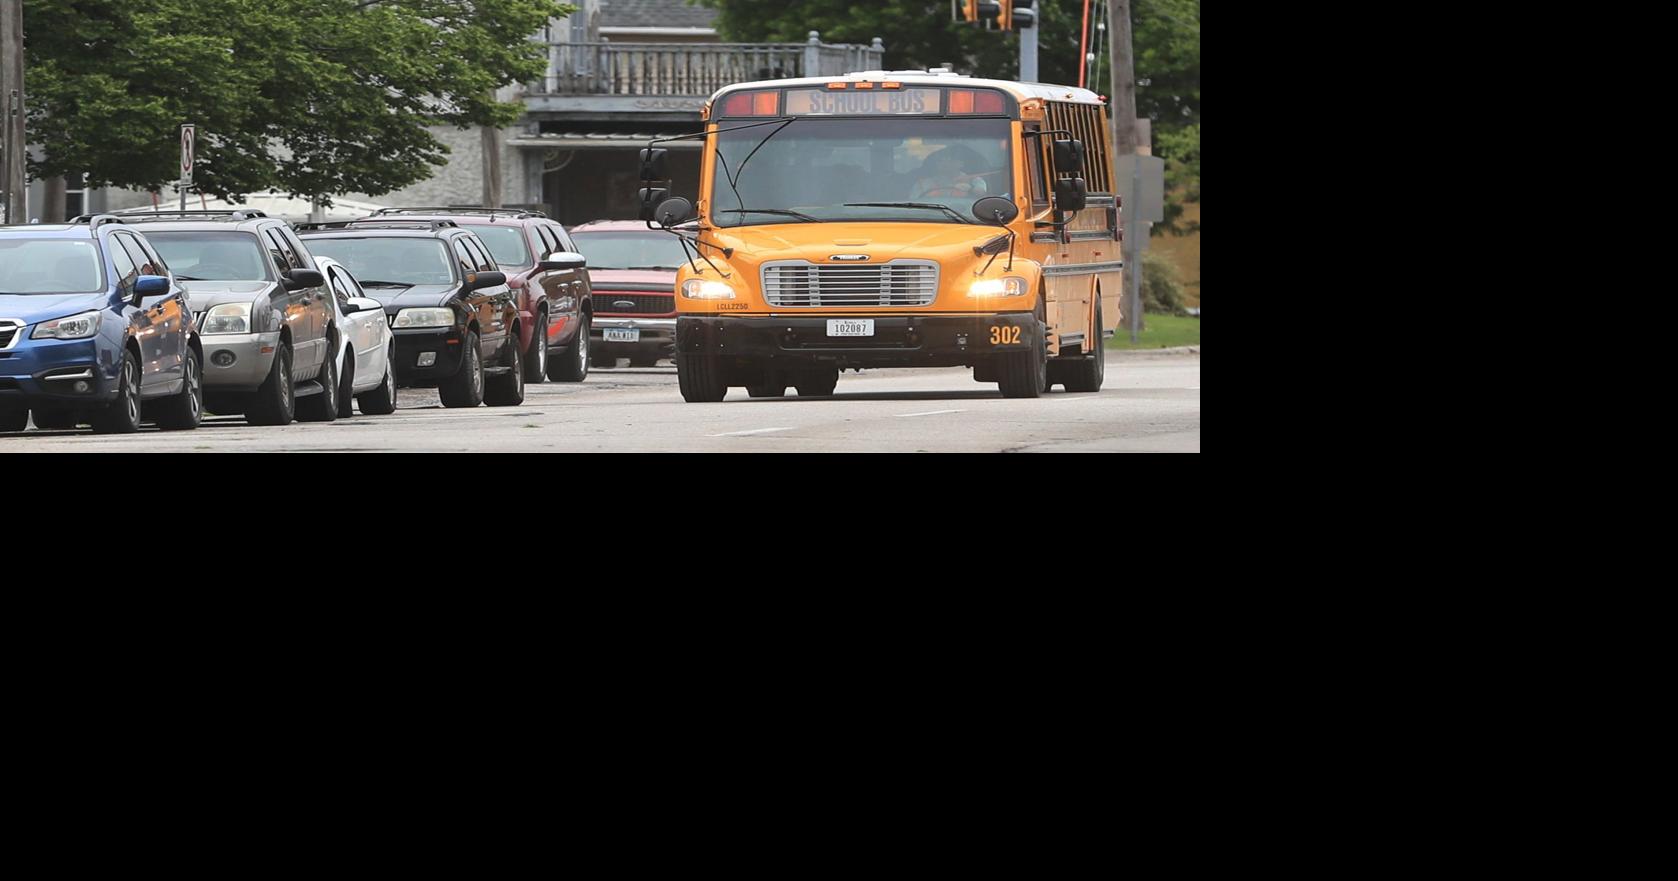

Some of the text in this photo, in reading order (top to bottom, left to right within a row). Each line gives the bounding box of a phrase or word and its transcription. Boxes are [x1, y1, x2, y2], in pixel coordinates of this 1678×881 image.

[809, 91, 925, 114] SCHOOL BUS
[835, 324, 867, 333] 102087
[990, 325, 1021, 345] 302
